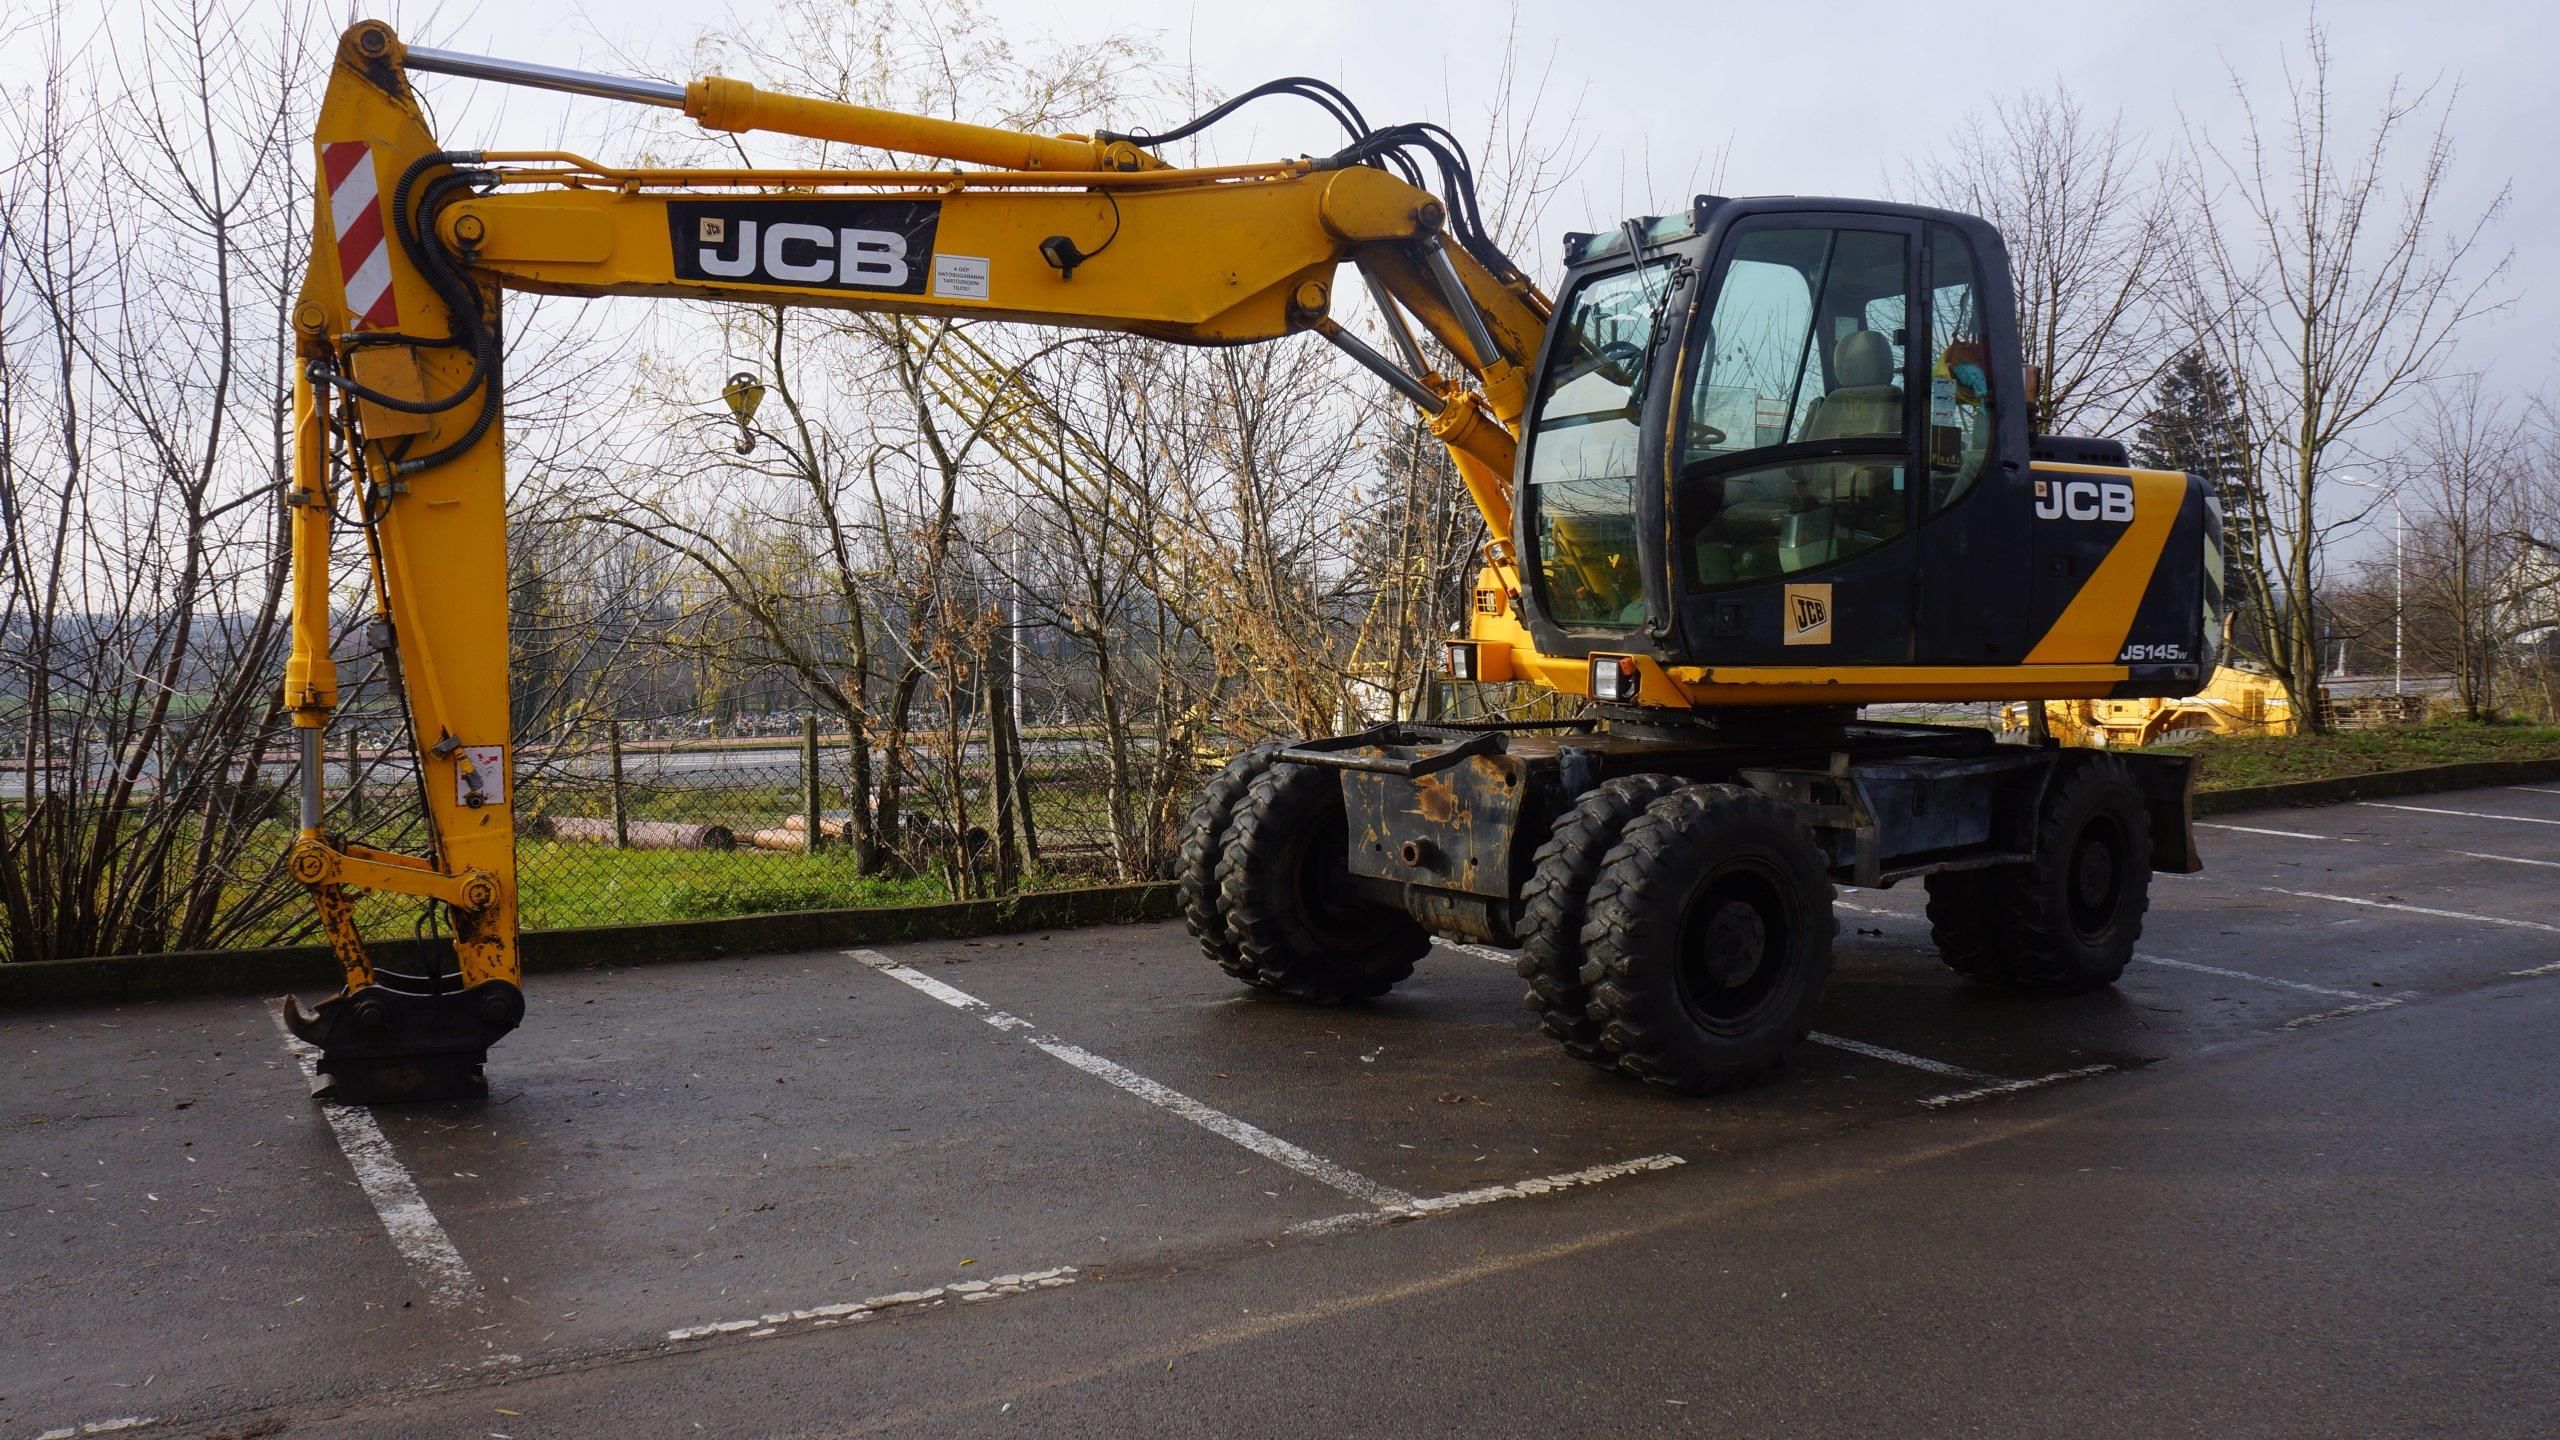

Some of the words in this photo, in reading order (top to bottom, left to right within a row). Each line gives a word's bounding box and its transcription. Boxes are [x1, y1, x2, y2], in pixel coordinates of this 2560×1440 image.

[705, 223, 720, 236] JCB
[699, 220, 908, 287] JCB
[2035, 481, 2135, 522] JCB
[1797, 598, 1825, 629] JCB
